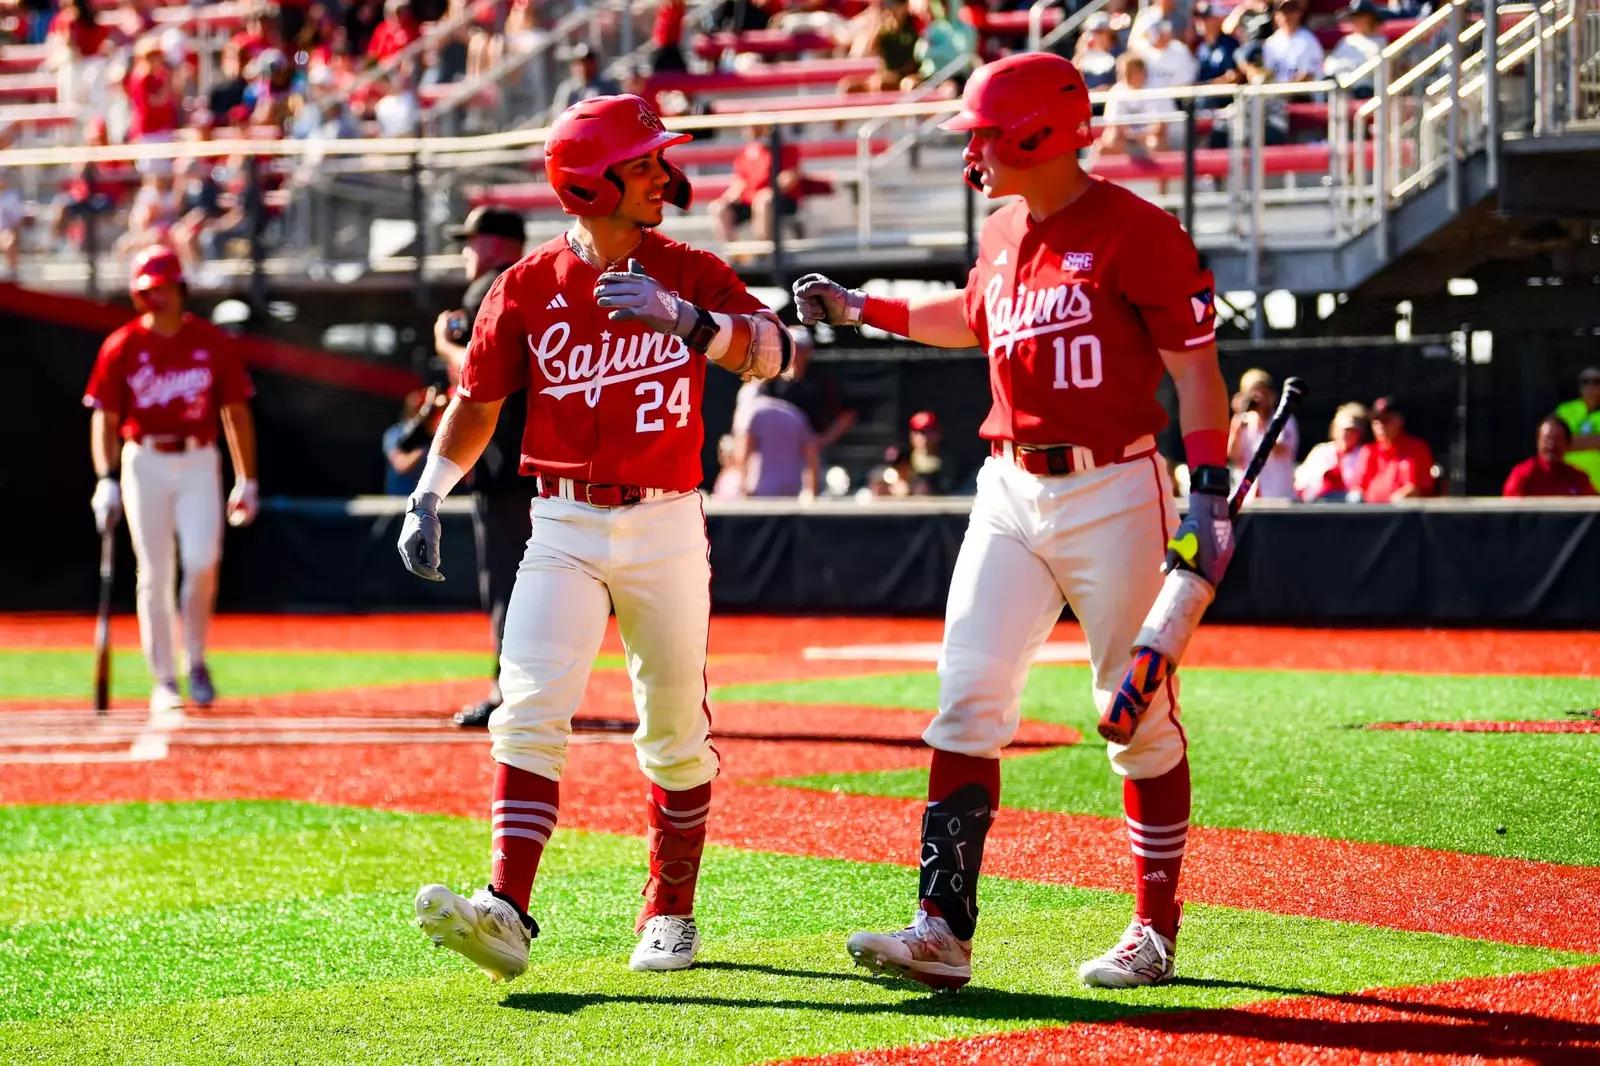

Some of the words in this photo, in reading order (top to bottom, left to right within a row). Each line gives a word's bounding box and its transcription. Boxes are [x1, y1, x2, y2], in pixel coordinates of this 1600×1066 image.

[655, 291, 678, 319] adidas
[527, 321, 691, 408] Cajuns
[1052, 334, 1103, 389] 10
[634, 377, 691, 433] 24
